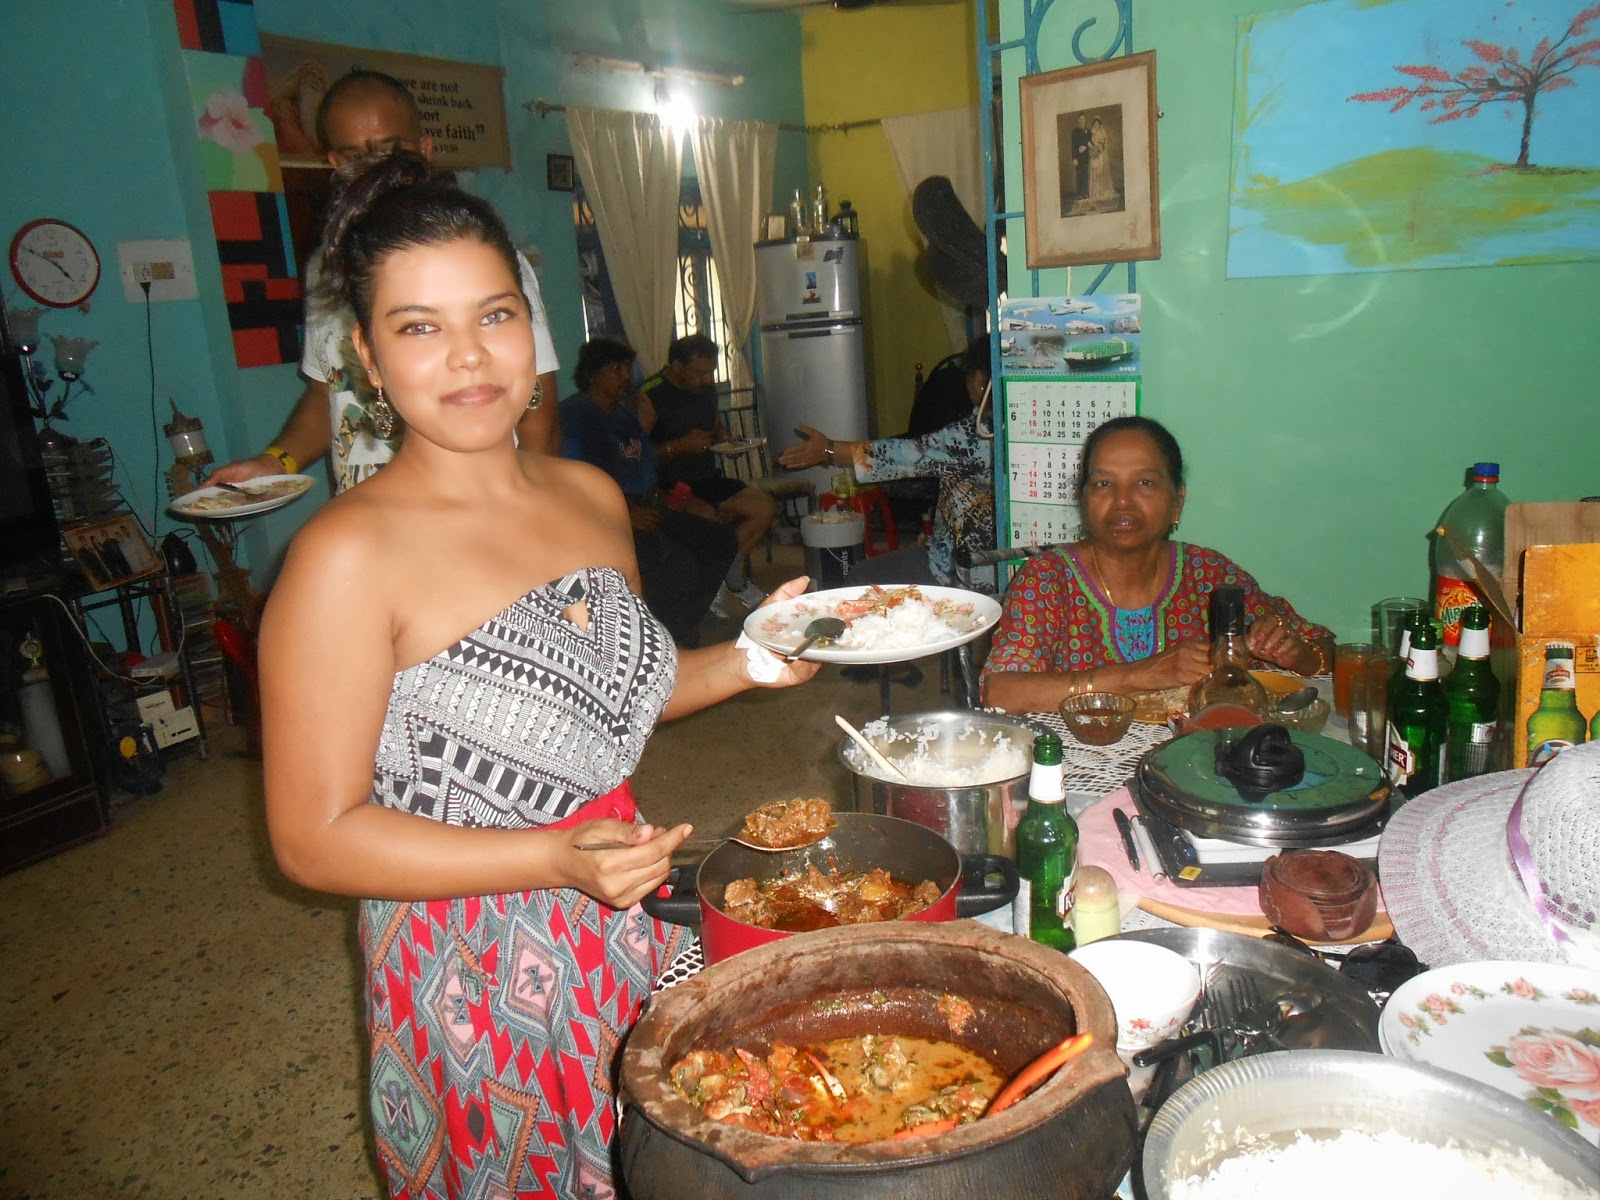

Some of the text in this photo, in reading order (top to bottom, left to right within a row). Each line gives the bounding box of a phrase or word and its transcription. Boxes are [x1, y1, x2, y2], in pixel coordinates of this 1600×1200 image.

[421, 80, 437, 91] are
[440, 82, 458, 93] not
[417, 93, 473, 109] shrink back
[417, 111, 439, 121] sort
[1011, 412, 1016, 421] 6
[1013, 472, 1017, 481] 7
[1058, 482, 1067, 490] 23
[1015, 530, 1020, 539] 8
